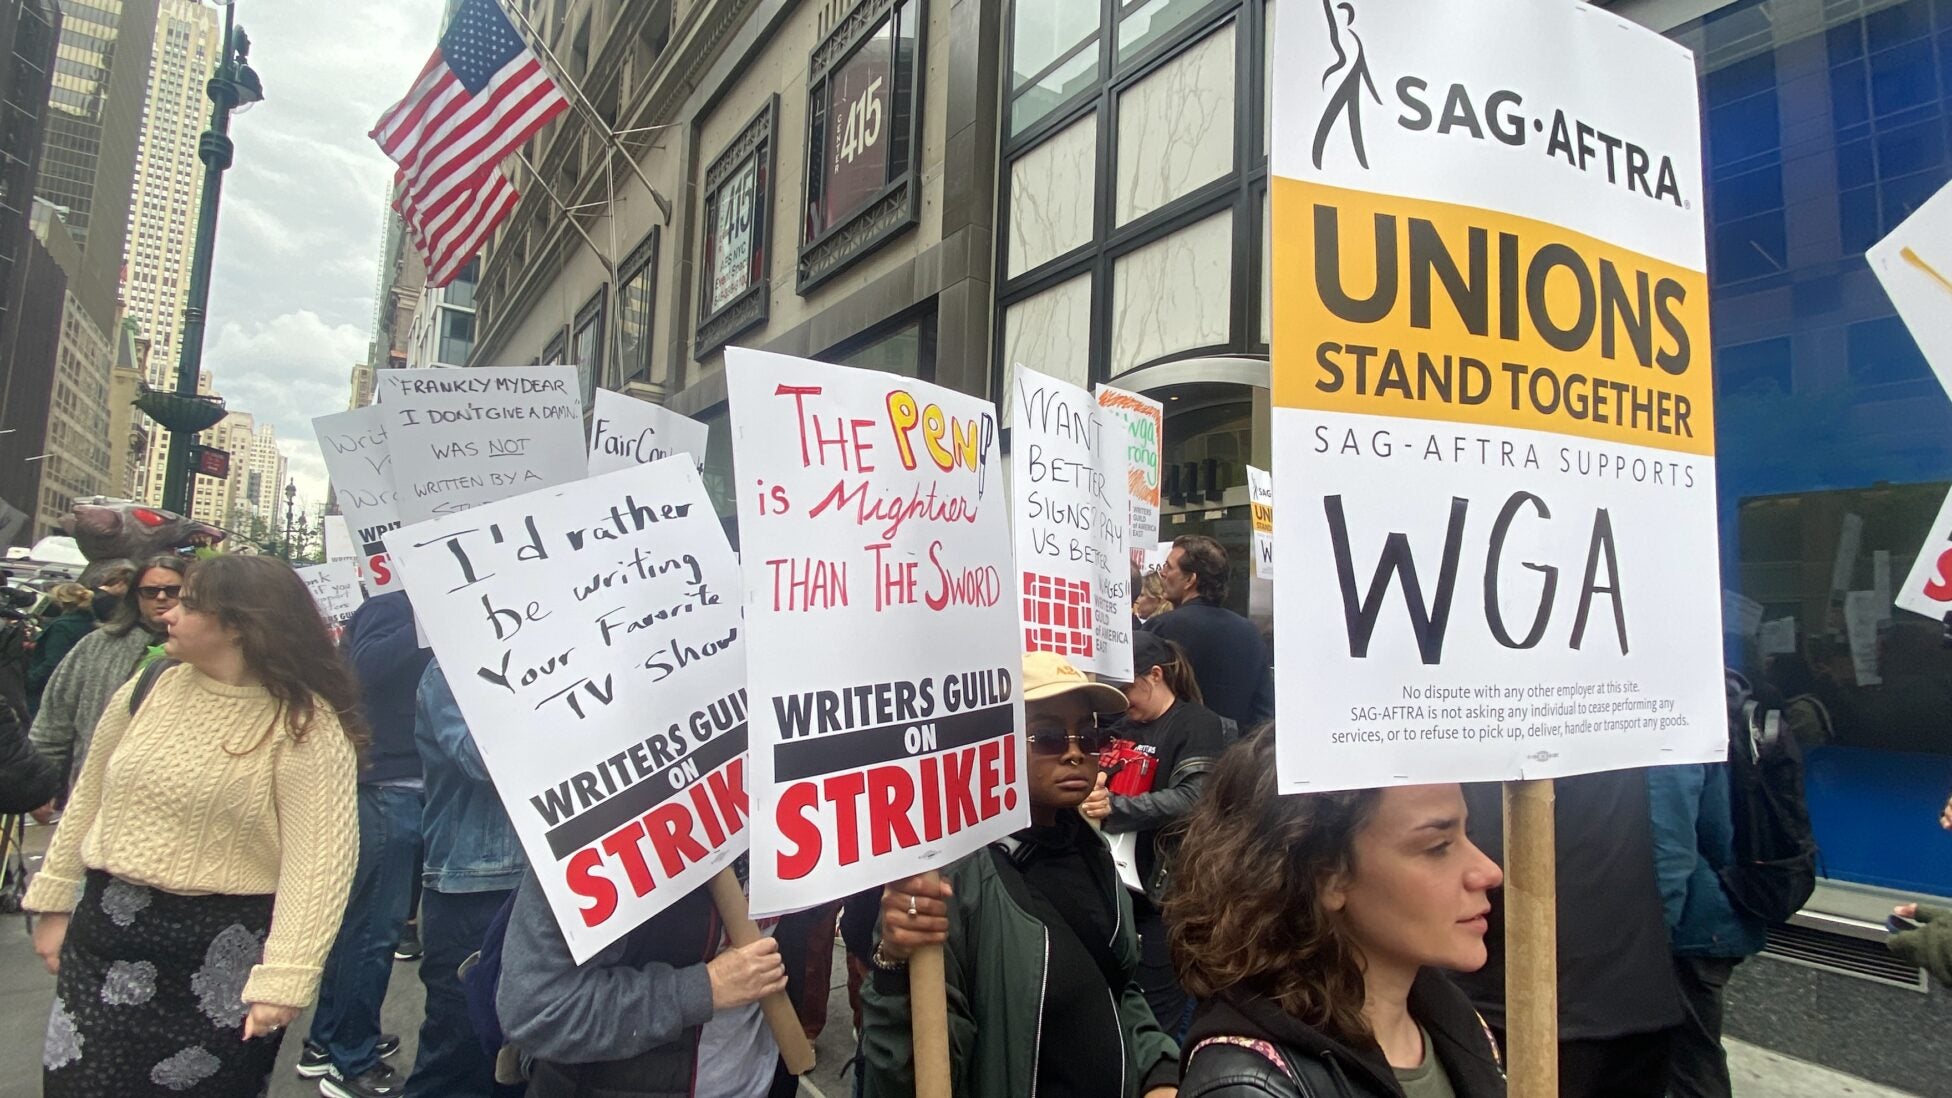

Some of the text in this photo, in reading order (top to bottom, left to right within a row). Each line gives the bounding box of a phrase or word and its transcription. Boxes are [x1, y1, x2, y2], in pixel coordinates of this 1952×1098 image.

[840, 75, 882, 164] 415
[724, 168, 753, 245] 415
[1313, 203, 1691, 376] UNIONS
[399, 409, 420, 426] I
[427, 402, 483, 424] DON'T
[486, 406, 524, 420] GIVE
[529, 405, 541, 420] A
[496, 377, 518, 394] MY
[521, 377, 568, 395] DEAR
[1315, 341, 1693, 438] STAND TOGETHER
[324, 424, 388, 454] Writ
[431, 437, 531, 460] WAS NOT
[594, 418, 637, 457] Fair
[774, 384, 876, 473] THE
[1018, 377, 1103, 458] WANT
[414, 469, 543, 498] WRITTEN BY A
[1029, 444, 1112, 508] BETTER
[1128, 446, 1157, 487] rong
[1314, 424, 1695, 488] SAG-AFTRA SUPPORTS
[756, 479, 978, 540] is Mightier
[1255, 505, 1273, 522] UNI
[412, 515, 549, 594] I'd
[566, 495, 693, 551] rather
[1032, 527, 1060, 557] US
[481, 547, 702, 641] be writing
[766, 557, 848, 612] THAN
[864, 543, 919, 612] THE
[1094, 594, 1117, 614] WRITERS
[1323, 490, 1630, 665] WGA
[477, 584, 722, 694] Your Favorite
[1095, 609, 1109, 626] GUILD
[1101, 627, 1129, 644] AMERICA
[535, 628, 737, 719] TV Show
[772, 667, 1012, 740] WRITERS GUILD
[1402, 680, 1640, 702] No dispute with any other employer at this site.
[903, 722, 937, 756] ON
[1331, 714, 1690, 744] services, or to refuse to pick up, deliver, handle or transport any goods.
[1350, 698, 1674, 722] SAG-AFTRA is not asking any individual to cease performing any
[529, 723, 688, 827] WRITERS
[668, 757, 699, 790] ON
[775, 734, 1018, 880] STRIKE!
[565, 757, 750, 928] STRIK
